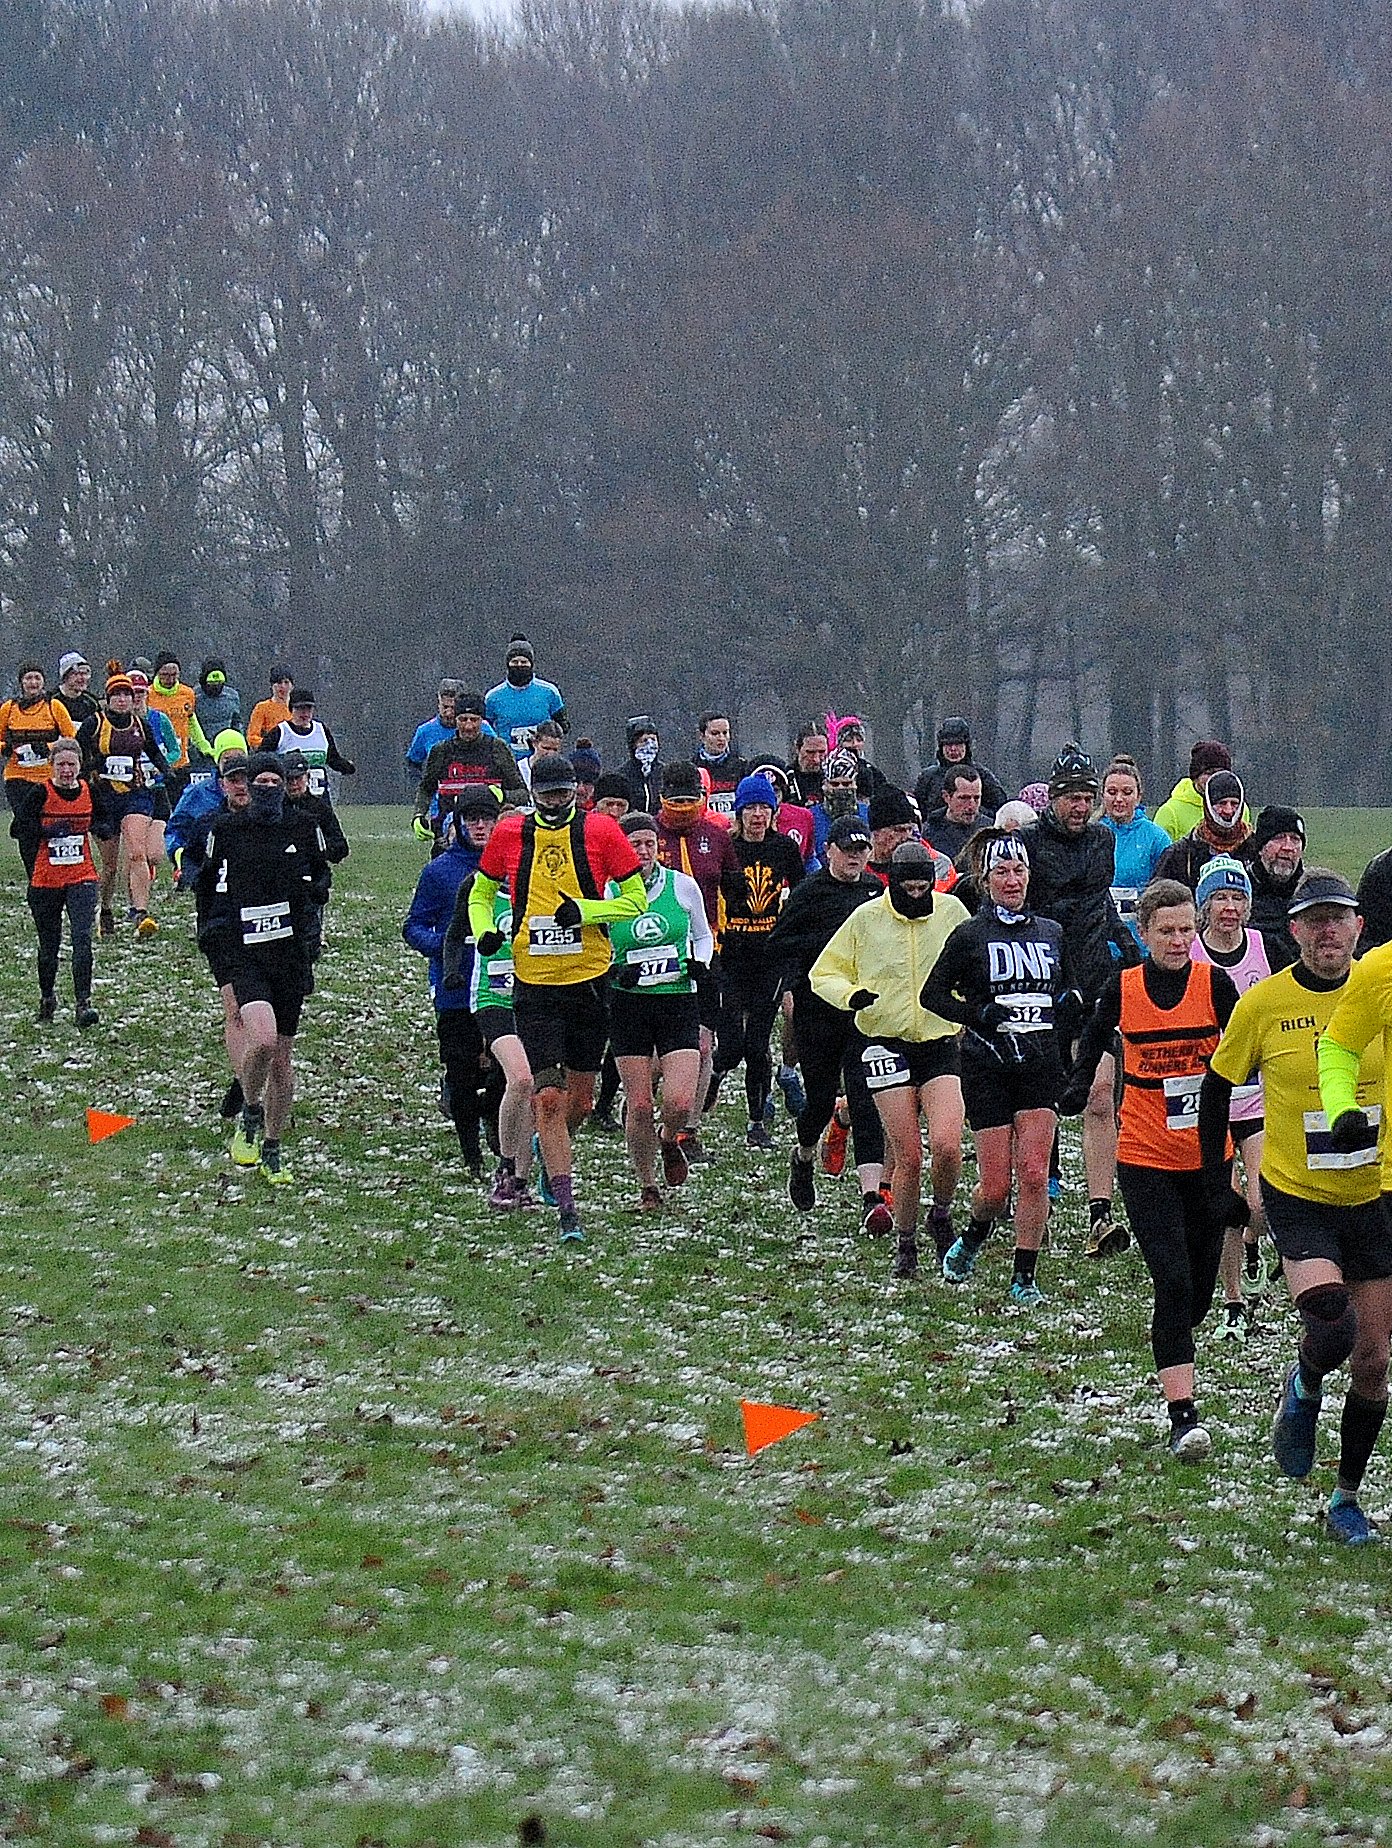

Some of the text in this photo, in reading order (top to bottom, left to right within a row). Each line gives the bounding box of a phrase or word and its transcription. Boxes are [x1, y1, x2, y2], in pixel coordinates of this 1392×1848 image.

[252, 917, 281, 933] 754
[535, 930, 574, 944] 1255
[640, 962, 668, 976] 377
[987, 942, 1055, 982] DNF
[1281, 1016, 1316, 1032] RICH
[869, 1058, 897, 1076] 115
